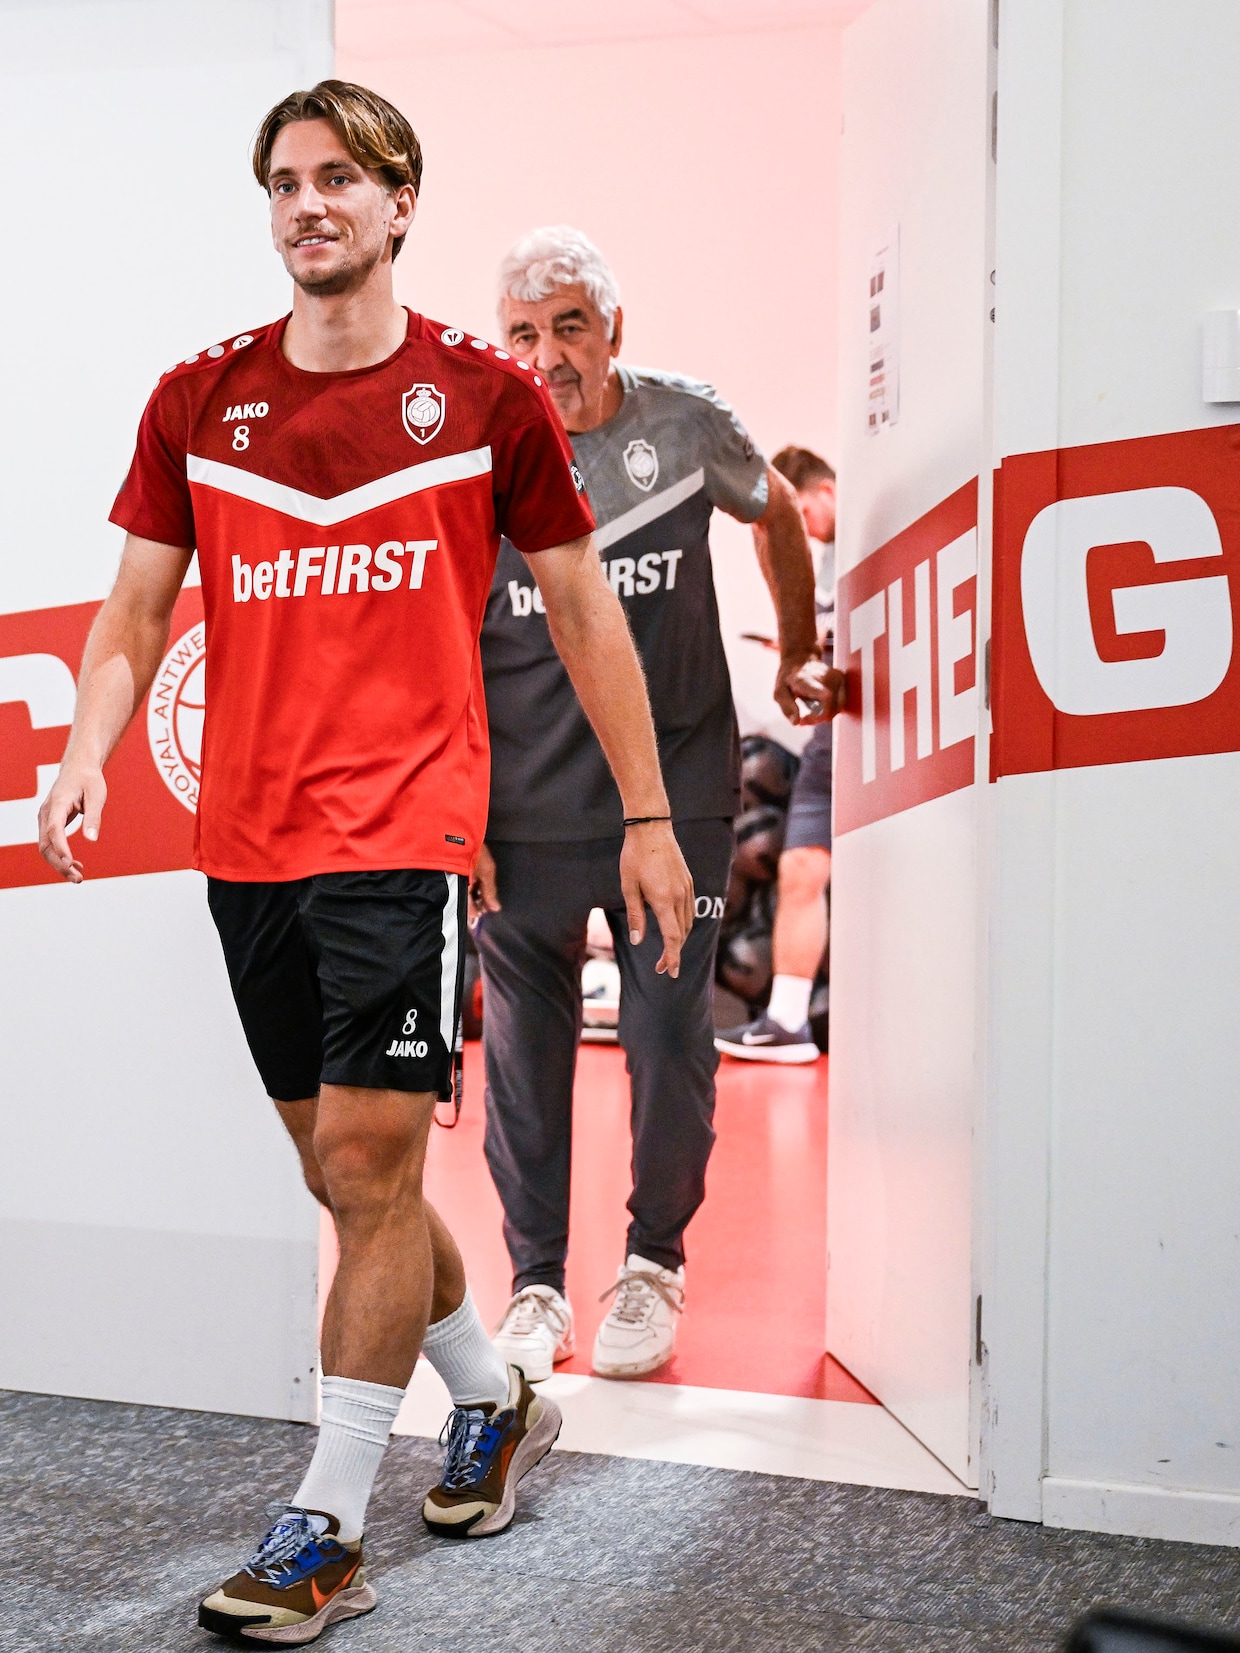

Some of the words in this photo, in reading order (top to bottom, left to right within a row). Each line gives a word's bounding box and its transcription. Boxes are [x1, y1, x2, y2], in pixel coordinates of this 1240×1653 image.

[222, 402, 268, 421] JAKO
[232, 425, 249, 450] 8
[232, 540, 437, 603] betFIRST
[1020, 486, 1233, 716] G
[850, 526, 977, 784] THE
[156, 728, 198, 806] ROYAL
[401, 1008, 418, 1035] 8
[386, 1040, 428, 1058] JAKO
